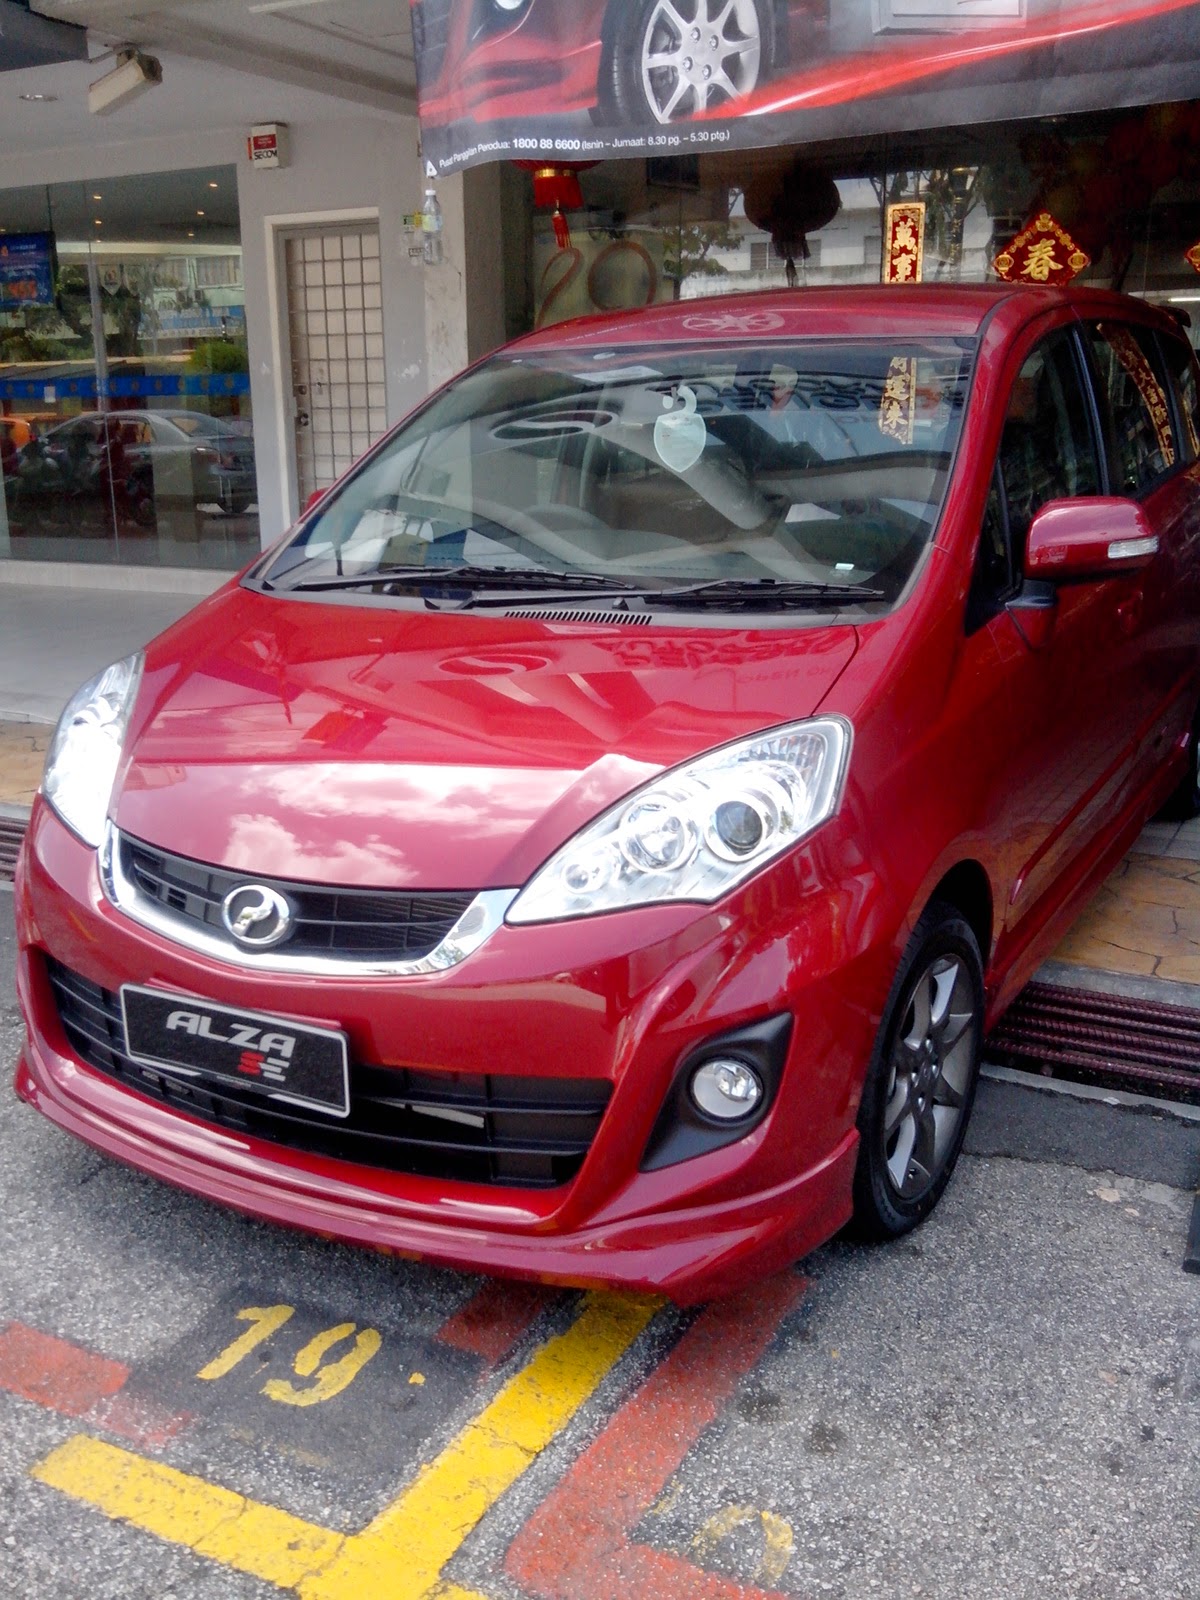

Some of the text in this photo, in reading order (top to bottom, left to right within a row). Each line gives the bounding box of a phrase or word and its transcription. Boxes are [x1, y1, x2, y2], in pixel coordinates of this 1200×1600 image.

[478, 140, 511, 153] Perodua:
[513, 138, 538, 149] 1800
[539, 138, 553, 149] 88
[554, 139, 580, 150] 6600
[581, 139, 604, 151] (Isnin
[612, 137, 646, 148] Jumaat:
[647, 136, 667, 146] 8.30
[668, 136, 681, 146] pg.
[690, 131, 709, 142] 5.30
[710, 129, 730, 142] ptg.)
[1020, 238, 1064, 281] 春
[166, 1010, 296, 1058] ALZA
[196, 1304, 382, 1407] 19
